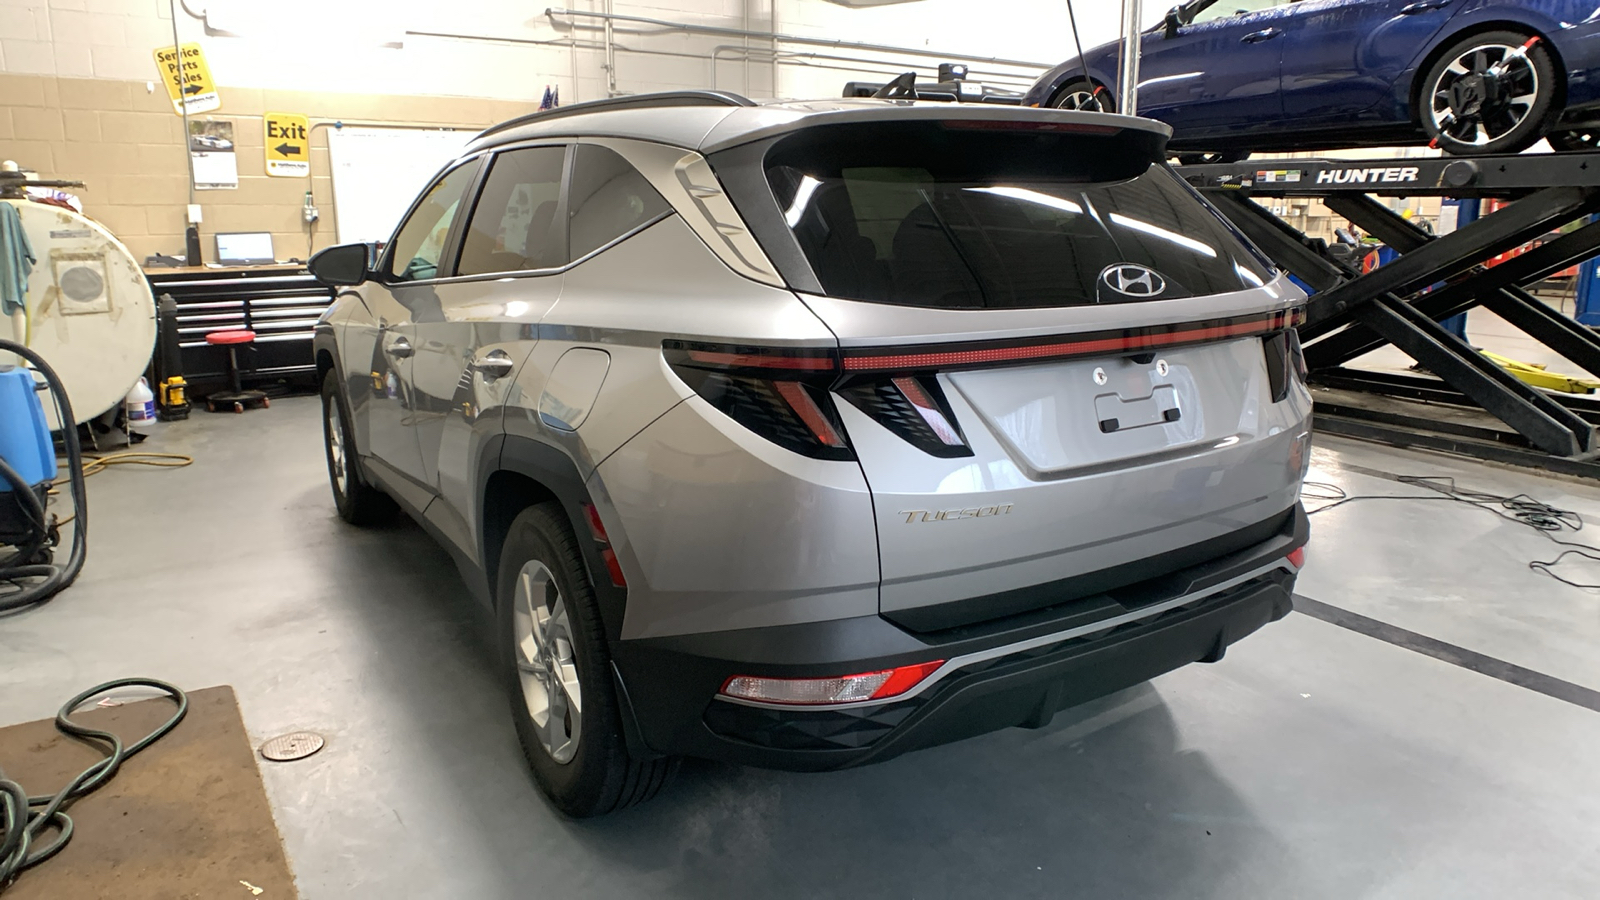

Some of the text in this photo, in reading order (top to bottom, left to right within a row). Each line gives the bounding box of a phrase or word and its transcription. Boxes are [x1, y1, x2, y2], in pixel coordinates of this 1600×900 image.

[267, 121, 306, 140] Exit
[1316, 167, 1419, 184] HUNTER
[897, 502, 1014, 524] TUCSON
